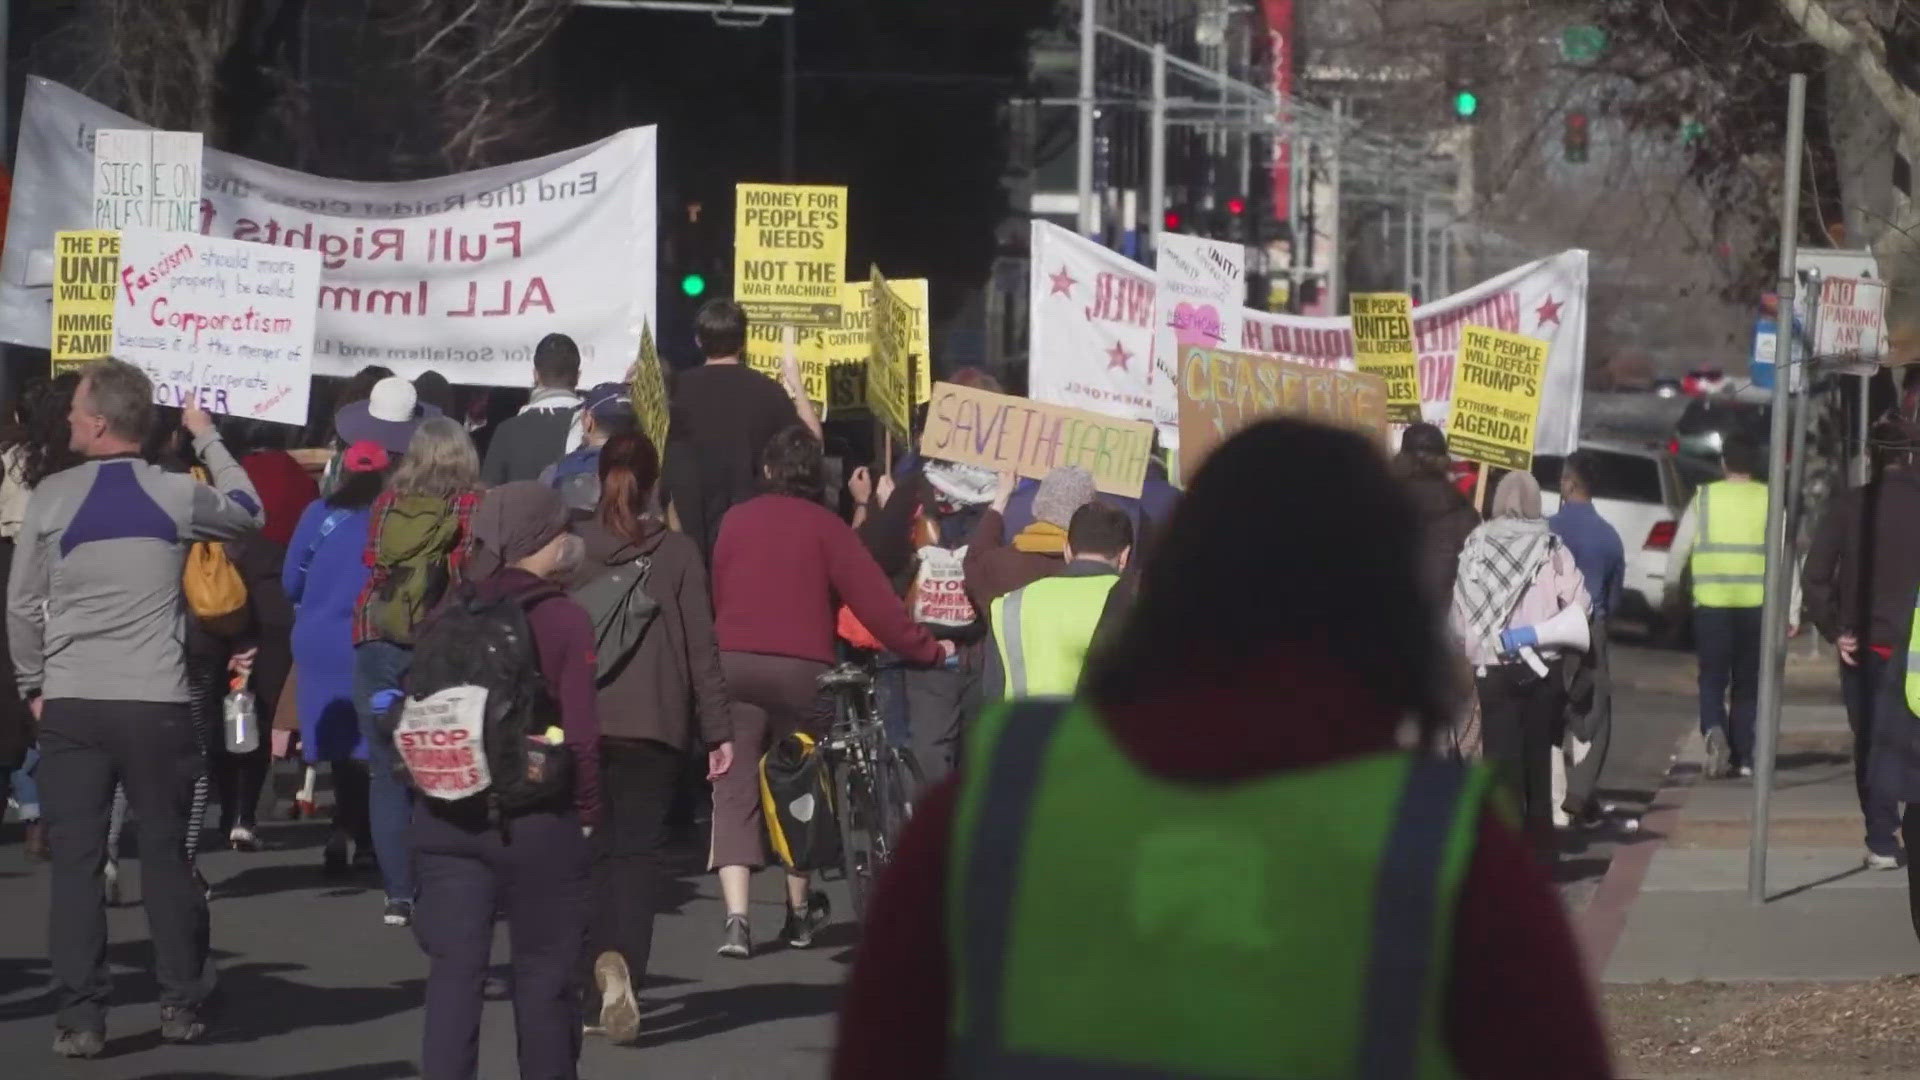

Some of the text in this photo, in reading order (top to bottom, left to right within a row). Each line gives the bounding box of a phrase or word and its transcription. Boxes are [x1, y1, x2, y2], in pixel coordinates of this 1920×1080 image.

[100, 162, 197, 197] SIEGE ON
[745, 191, 838, 208] MONEY FOR
[96, 199, 199, 232] PALESTINE
[745, 208, 839, 229] PEOPLE'S
[61, 237, 93, 254] THE
[760, 229, 824, 249] NEEDS
[61, 257, 118, 284] UNIT
[744, 260, 836, 283] NOT THE
[1208, 246, 1240, 279] UNITY
[122, 244, 193, 306] Fascism
[200, 248, 249, 269] should
[170, 273, 225, 298] properly
[237, 273, 251, 294] be
[60, 285, 96, 301] WILL
[743, 283, 837, 298] WAR MACHINE!
[1825, 280, 1853, 305] NO
[1353, 299, 1407, 314] THE PEOPLE
[1824, 306, 1880, 328] PARKING
[58, 314, 112, 331] IMMIG
[151, 297, 292, 344] Corporatism
[1354, 315, 1409, 340] UNITED
[752, 325, 824, 349] RUP'S
[1357, 340, 1373, 353] WILL
[1467, 332, 1542, 362] THE PEOPLE
[1836, 326, 1863, 344] ANY
[1465, 348, 1540, 376] WILL DEFEAT
[1387, 382, 1418, 400] LIES!
[1462, 363, 1537, 397] TRUMP'S
[157, 383, 229, 414] OWER
[936, 392, 1017, 462] SAVE
[1453, 411, 1529, 445] AGENDA!
[401, 729, 469, 747] STOP
